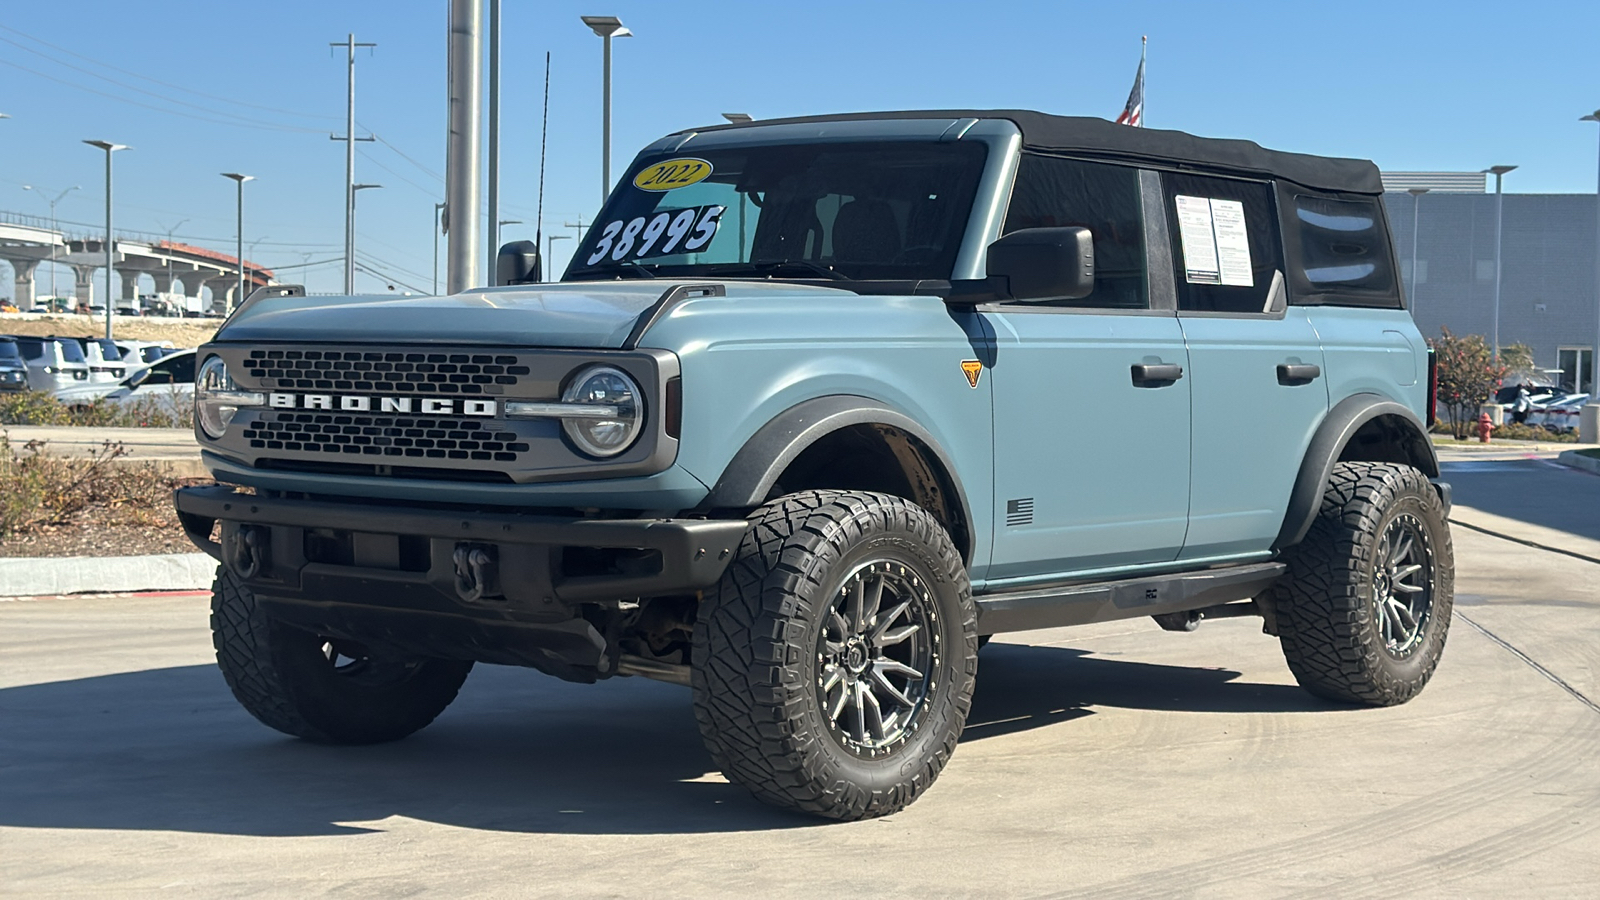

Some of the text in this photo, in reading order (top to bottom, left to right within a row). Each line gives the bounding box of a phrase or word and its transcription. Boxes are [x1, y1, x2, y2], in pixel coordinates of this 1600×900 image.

[642, 164, 703, 186] 2022
[587, 205, 726, 266] 38995
[269, 392, 497, 416] BRONCO
